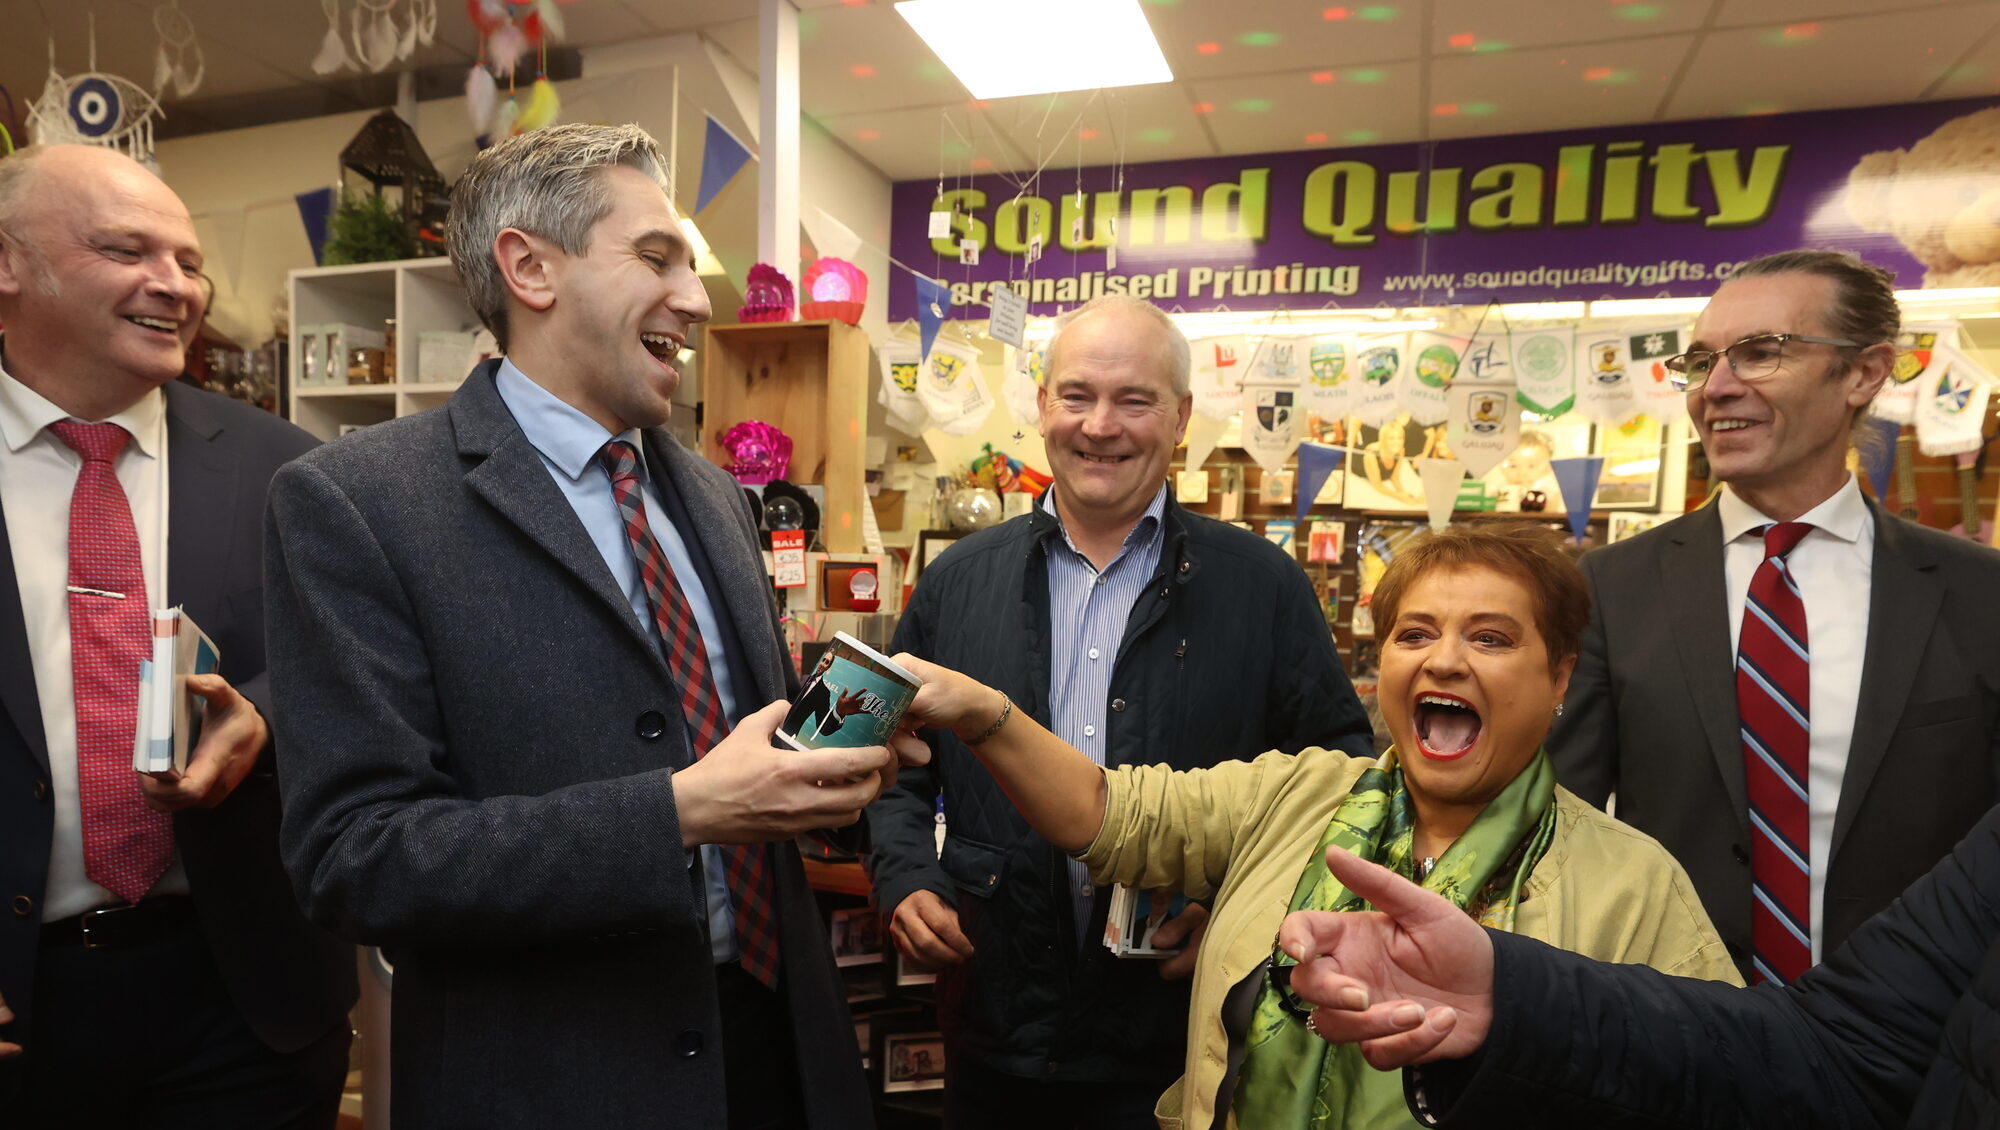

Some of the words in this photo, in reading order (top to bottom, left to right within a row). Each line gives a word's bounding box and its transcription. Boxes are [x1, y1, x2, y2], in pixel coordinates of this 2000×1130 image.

[930, 168, 1270, 256] Sound
[1303, 141, 1790, 244] Quality
[932, 267, 1178, 306] eronalised
[1188, 264, 1360, 299] Printing
[773, 538, 803, 547] SALE
[861, 692, 889, 721] The
